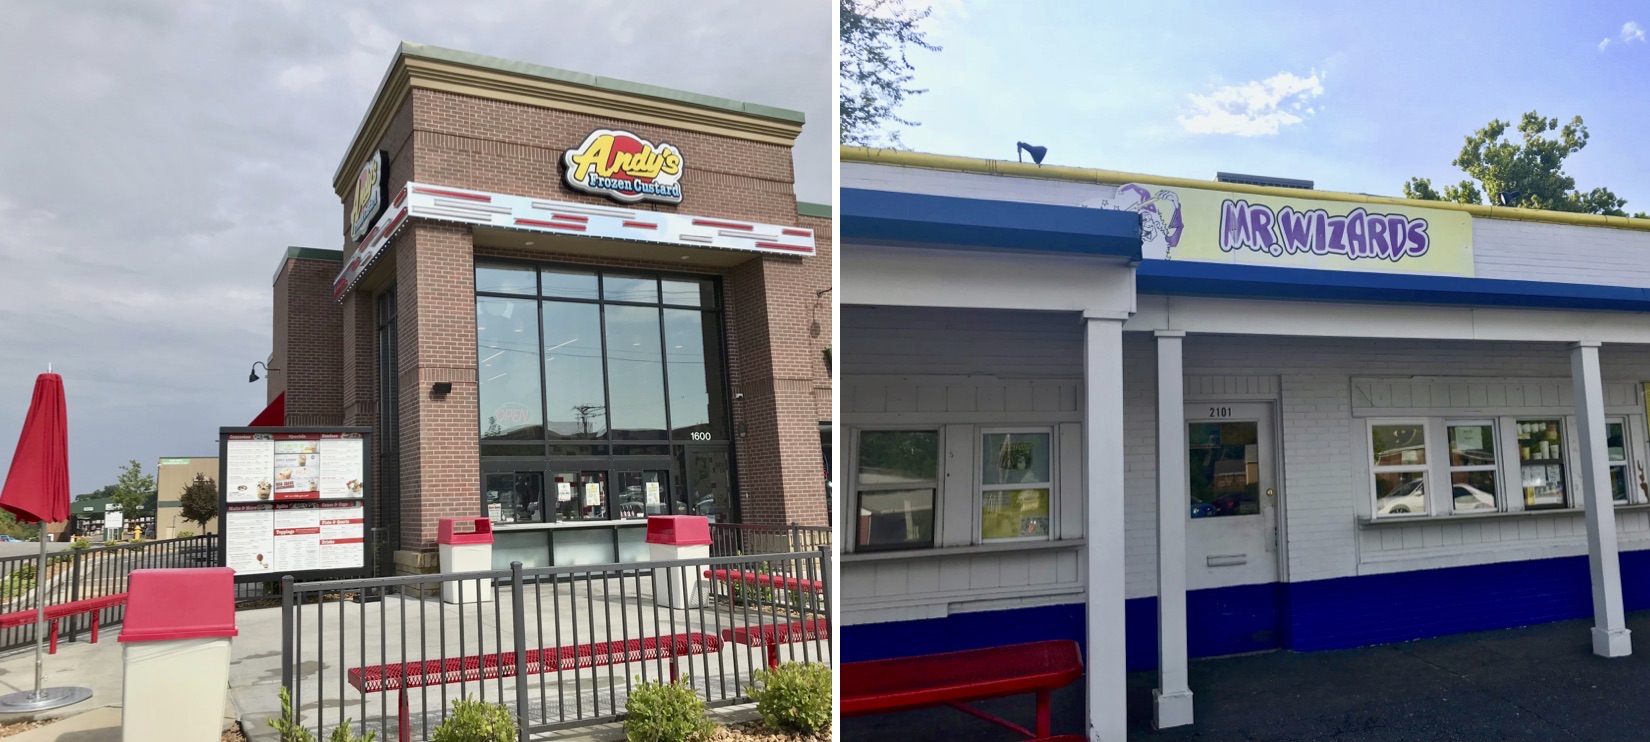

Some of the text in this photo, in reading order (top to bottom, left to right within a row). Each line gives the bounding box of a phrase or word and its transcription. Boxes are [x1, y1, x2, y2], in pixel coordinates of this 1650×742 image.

[573, 134, 680, 181] Andy's
[589, 173, 680, 196] Frozen Custard
[1220, 199, 1428, 261] MR. WIZARDS
[496, 409, 530, 423] OPEN
[1209, 407, 1231, 418] 2101
[691, 432, 711, 441] 1600
